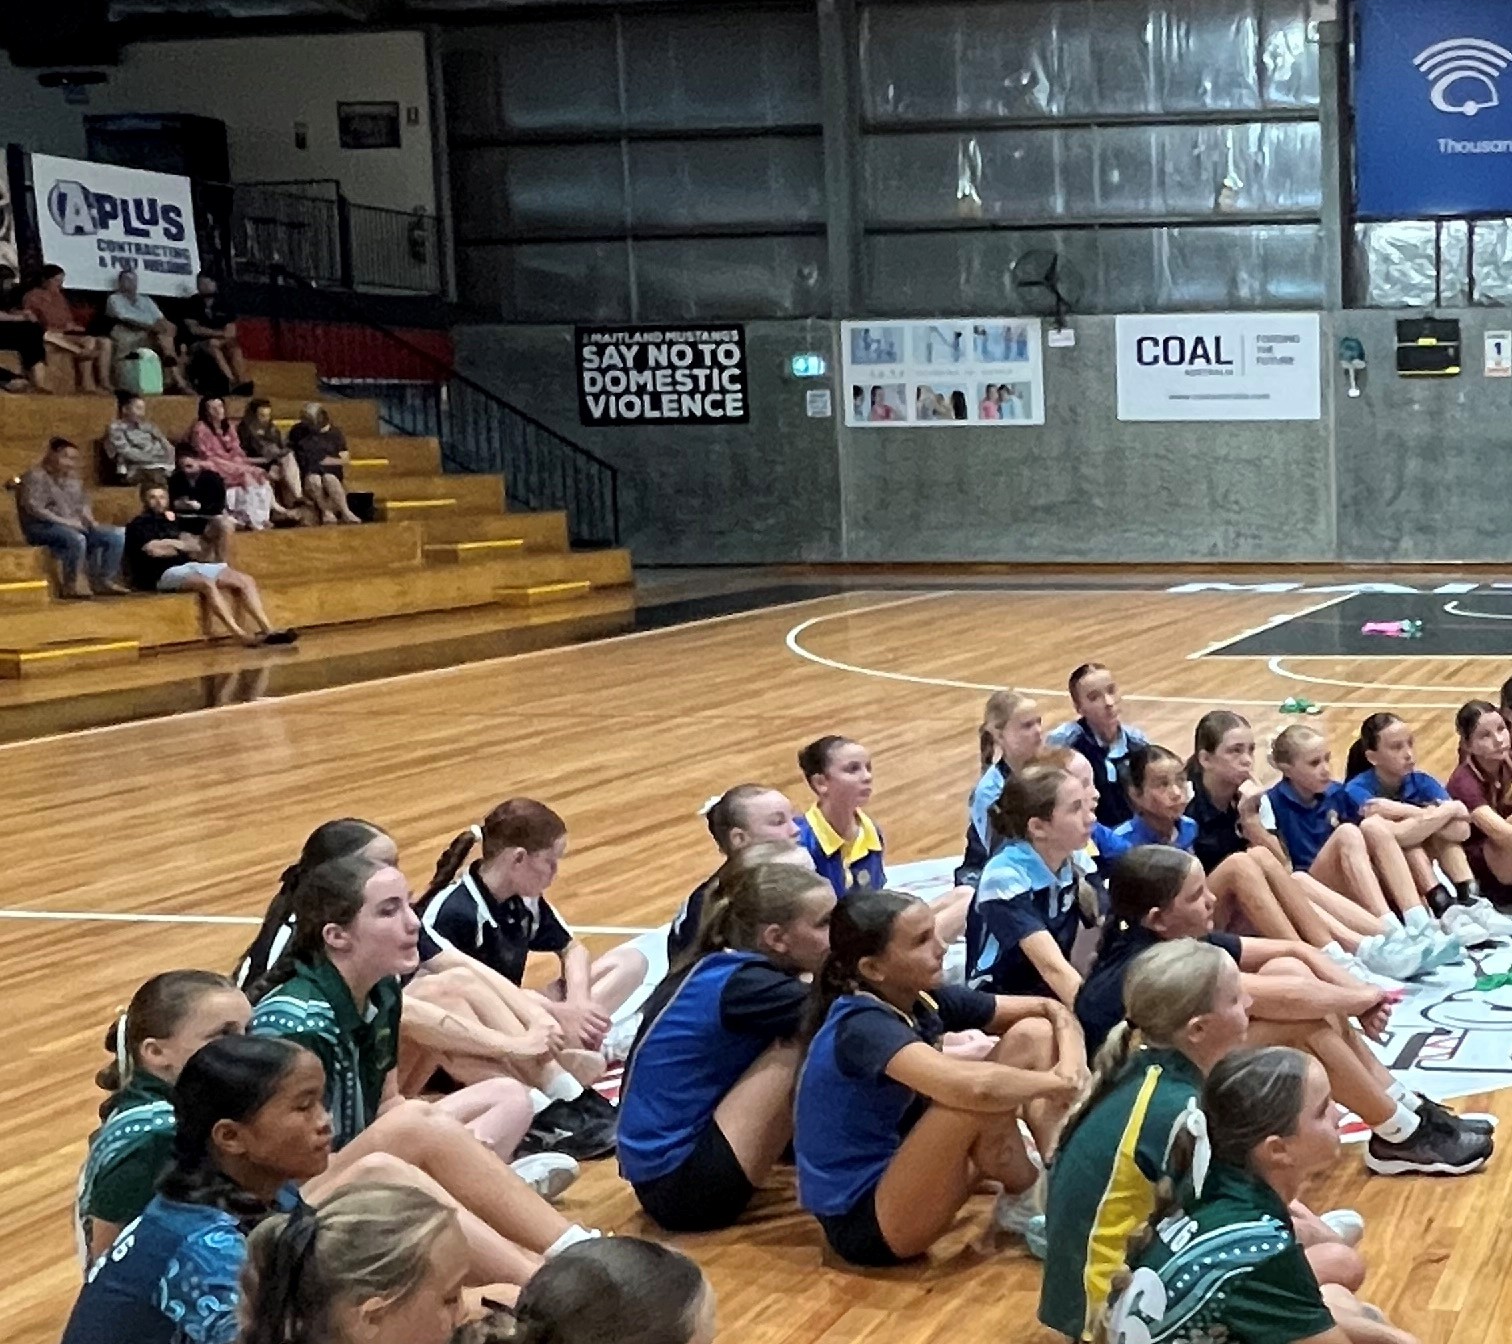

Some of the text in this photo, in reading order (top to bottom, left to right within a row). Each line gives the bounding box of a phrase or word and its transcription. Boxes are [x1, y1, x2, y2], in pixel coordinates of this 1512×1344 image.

[582, 342, 742, 369] SAY NO TO
[1136, 336, 1234, 366] COAL
[583, 368, 742, 394] DOMESTIC
[586, 393, 744, 419] VIOLENCE
